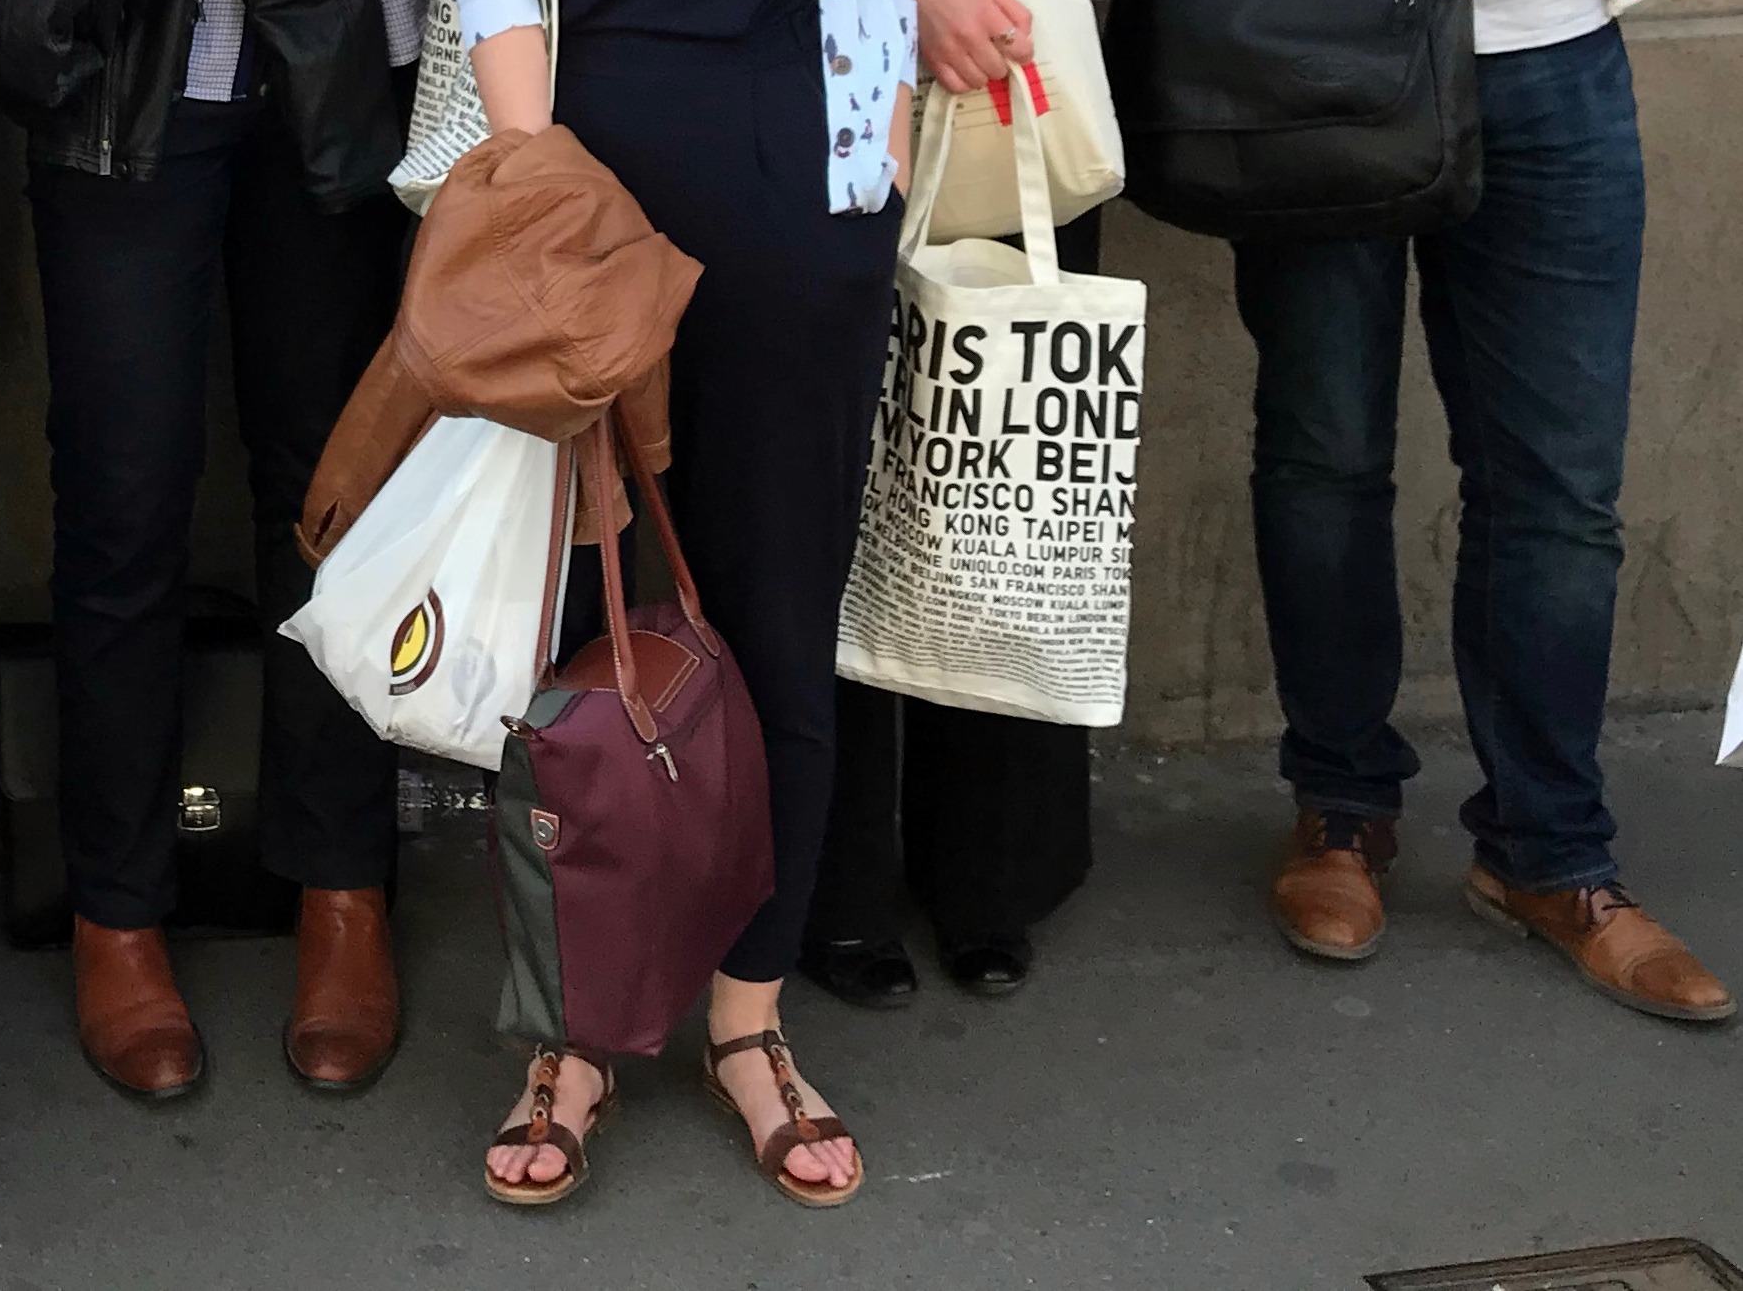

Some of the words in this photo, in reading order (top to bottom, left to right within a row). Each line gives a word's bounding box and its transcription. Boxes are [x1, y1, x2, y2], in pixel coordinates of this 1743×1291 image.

[1011, 320, 1138, 386] TOK
[1002, 387, 1139, 439] LOND
[910, 426, 1014, 479] YORK
[883, 448, 1033, 512] FRANCISCO
[886, 510, 942, 550] MOSCOW
[952, 538, 1017, 558] KUALA
[1027, 543, 1104, 563] LUMPUR
[888, 486, 931, 528] HONG
[945, 513, 1009, 536] KONG
[1023, 517, 1104, 543] TAIPEI
[910, 564, 963, 586] BEIJING
[970, 575, 999, 590] SAN
[1006, 579, 1085, 596] FRANCISCO
[1091, 583, 1127, 596] SHAN
[950, 557, 1045, 578] UNIQLO.COM
[1053, 566, 1096, 580] PARIS
[993, 595, 1044, 608] MOSCOW
